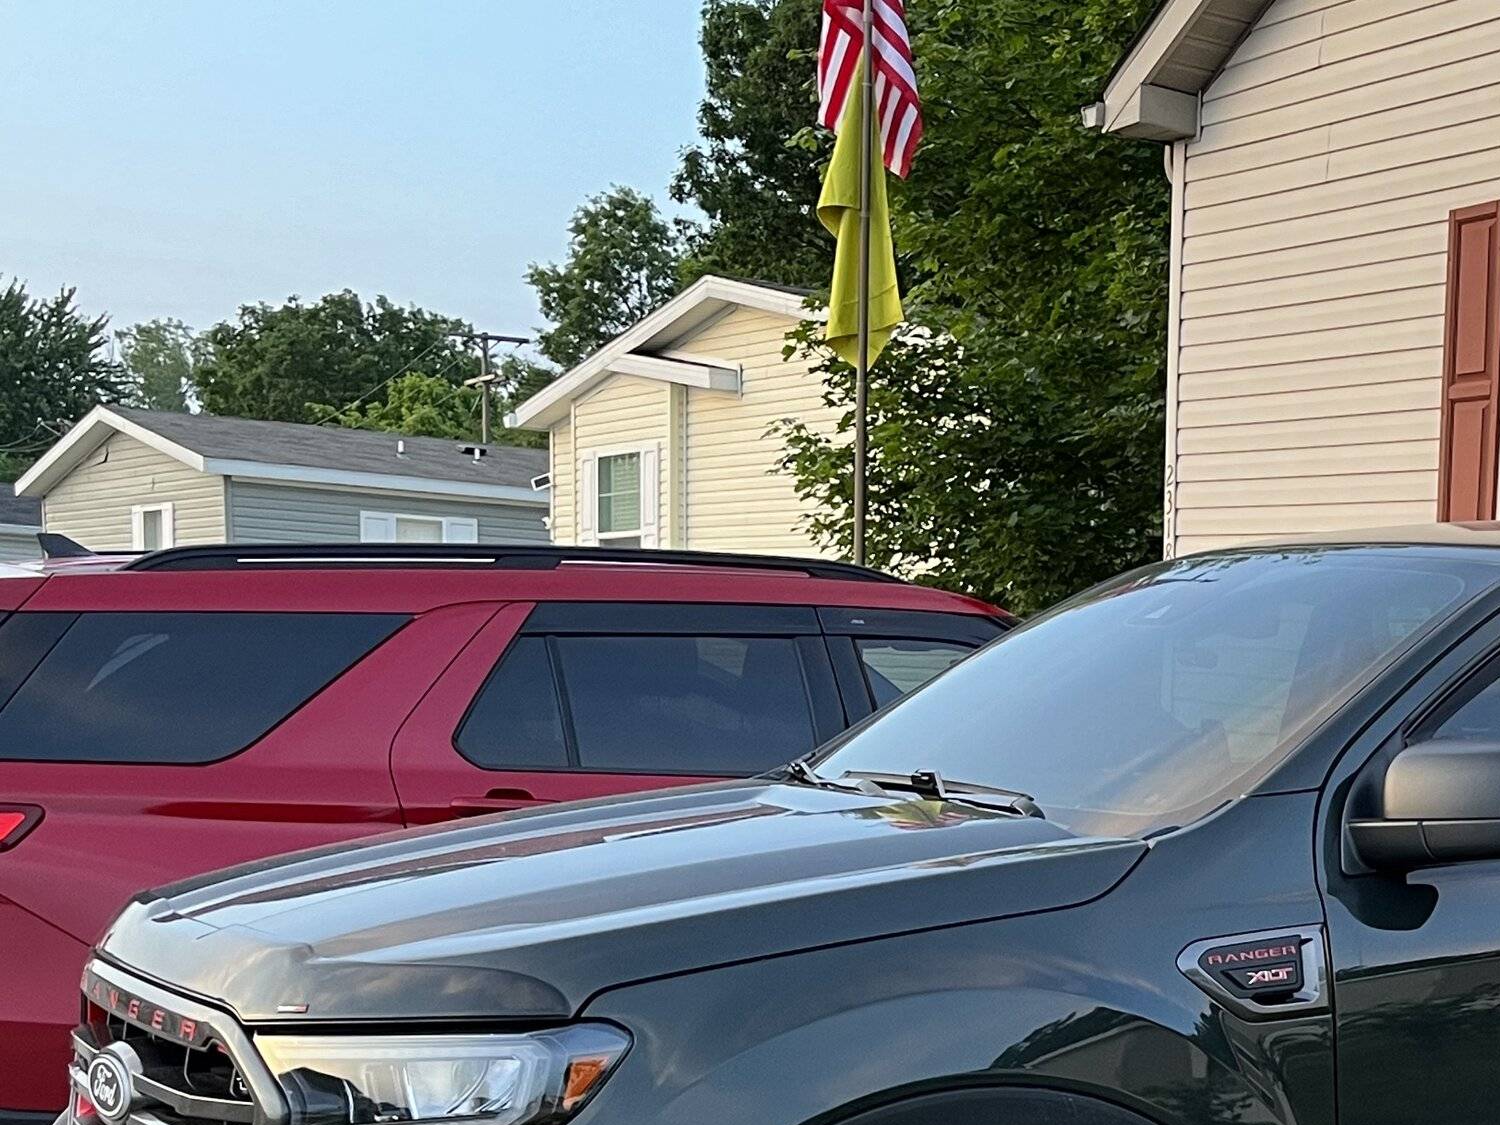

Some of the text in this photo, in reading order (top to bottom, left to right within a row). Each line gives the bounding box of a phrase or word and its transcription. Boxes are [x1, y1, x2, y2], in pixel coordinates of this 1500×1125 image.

[1207, 945, 1297, 965] RANGER
[81, 972, 197, 1042] ANGER
[93, 1064, 117, 1107] Ford
